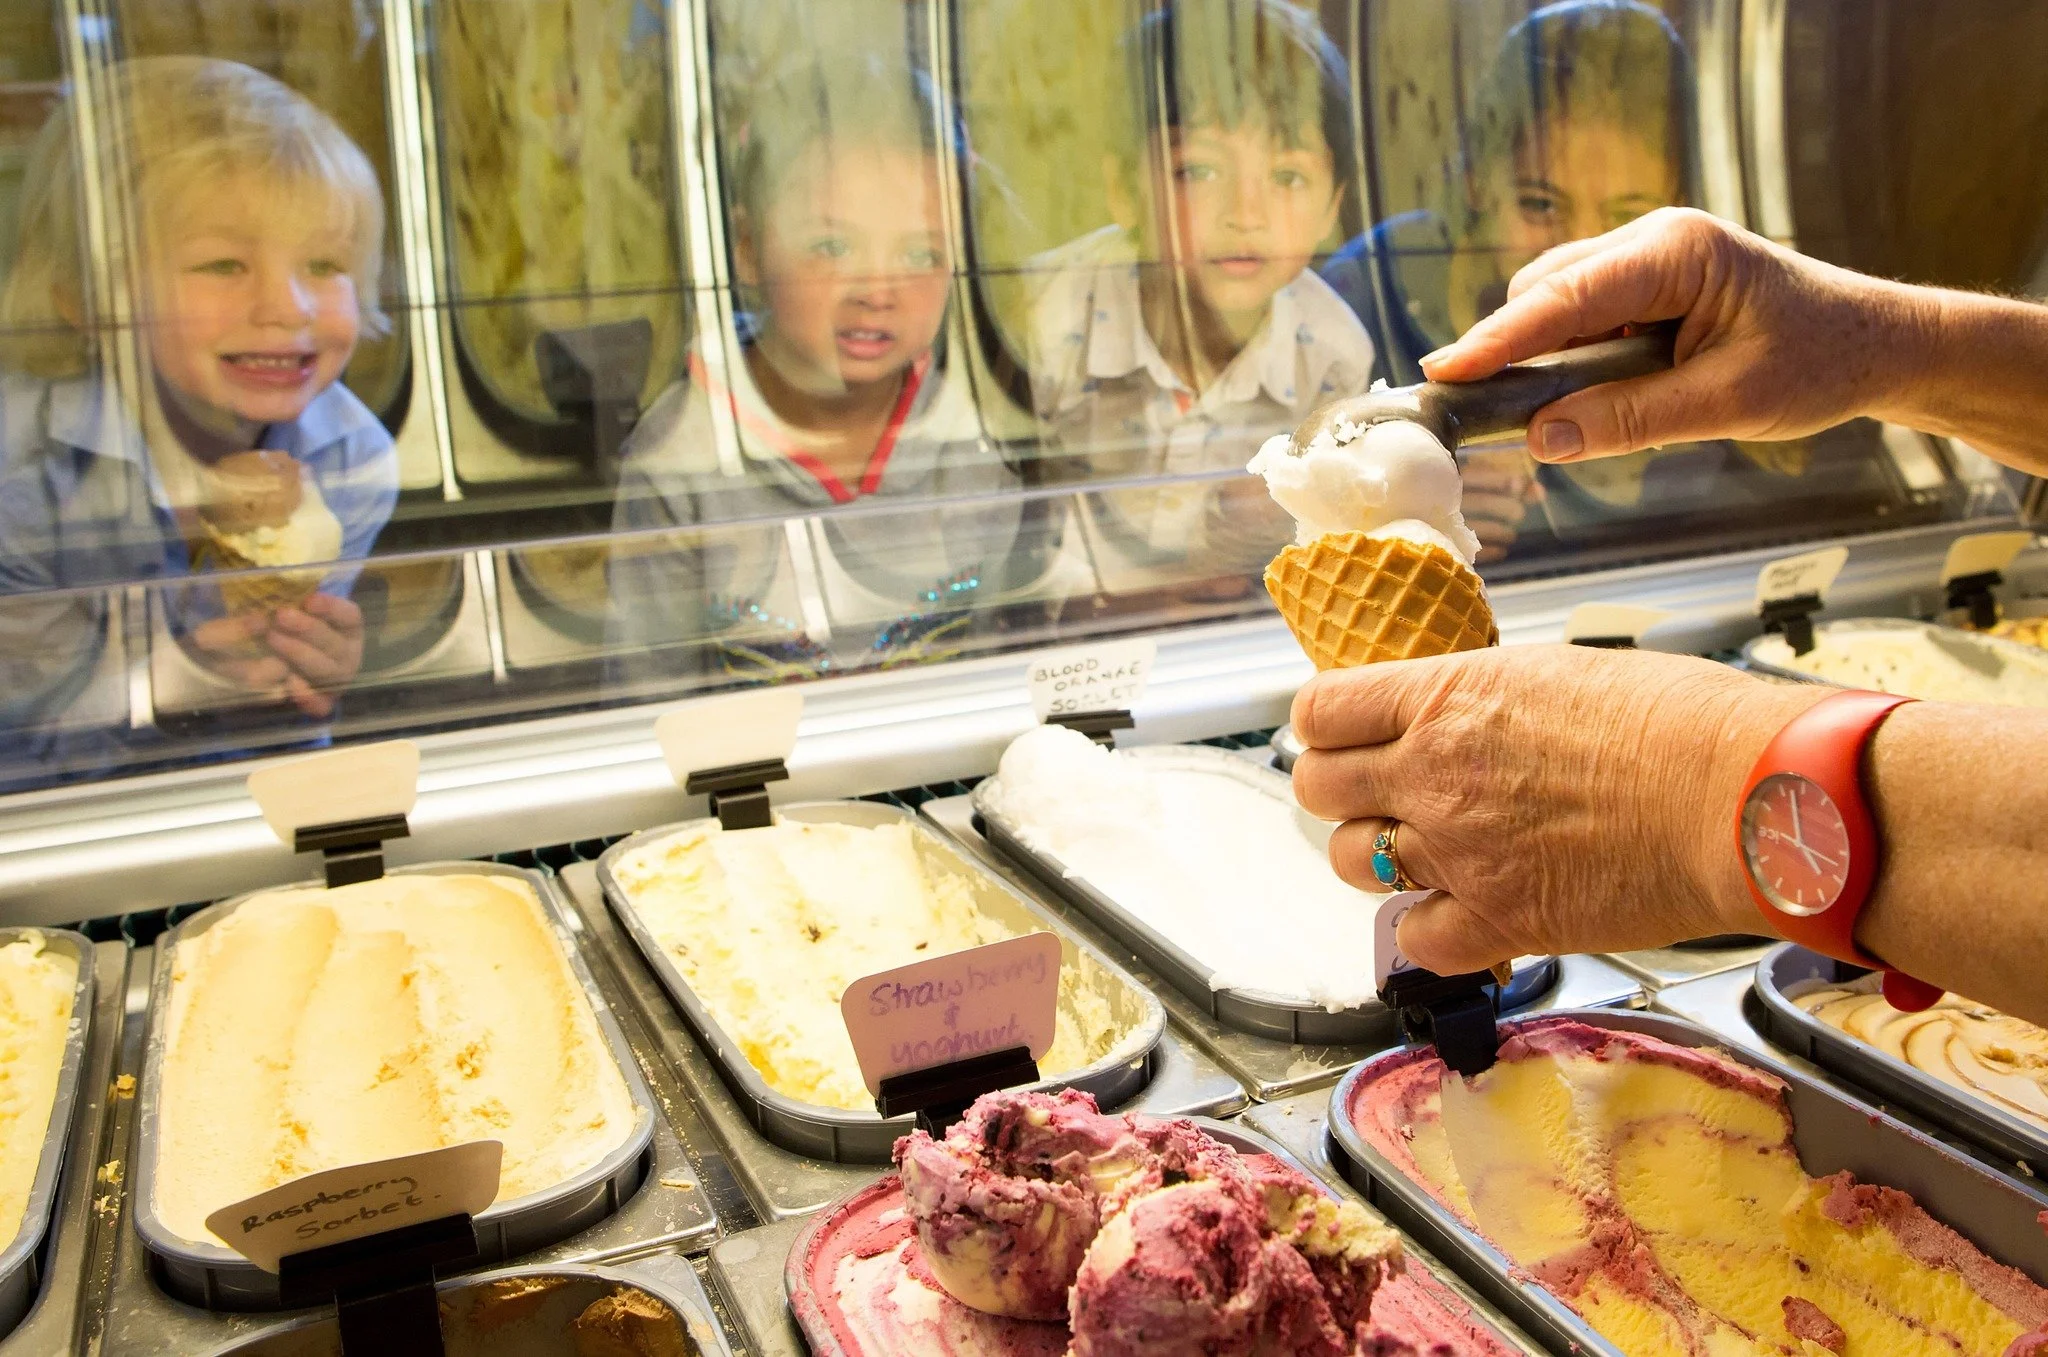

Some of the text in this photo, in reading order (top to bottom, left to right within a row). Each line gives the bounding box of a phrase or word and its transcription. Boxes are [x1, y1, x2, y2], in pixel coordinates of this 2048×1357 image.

[1035, 658, 1098, 682] BLOOD
[1758, 825, 1780, 845] ice
[869, 953, 1046, 1016] Strawberry
[240, 1176, 419, 1233] Raspberry
